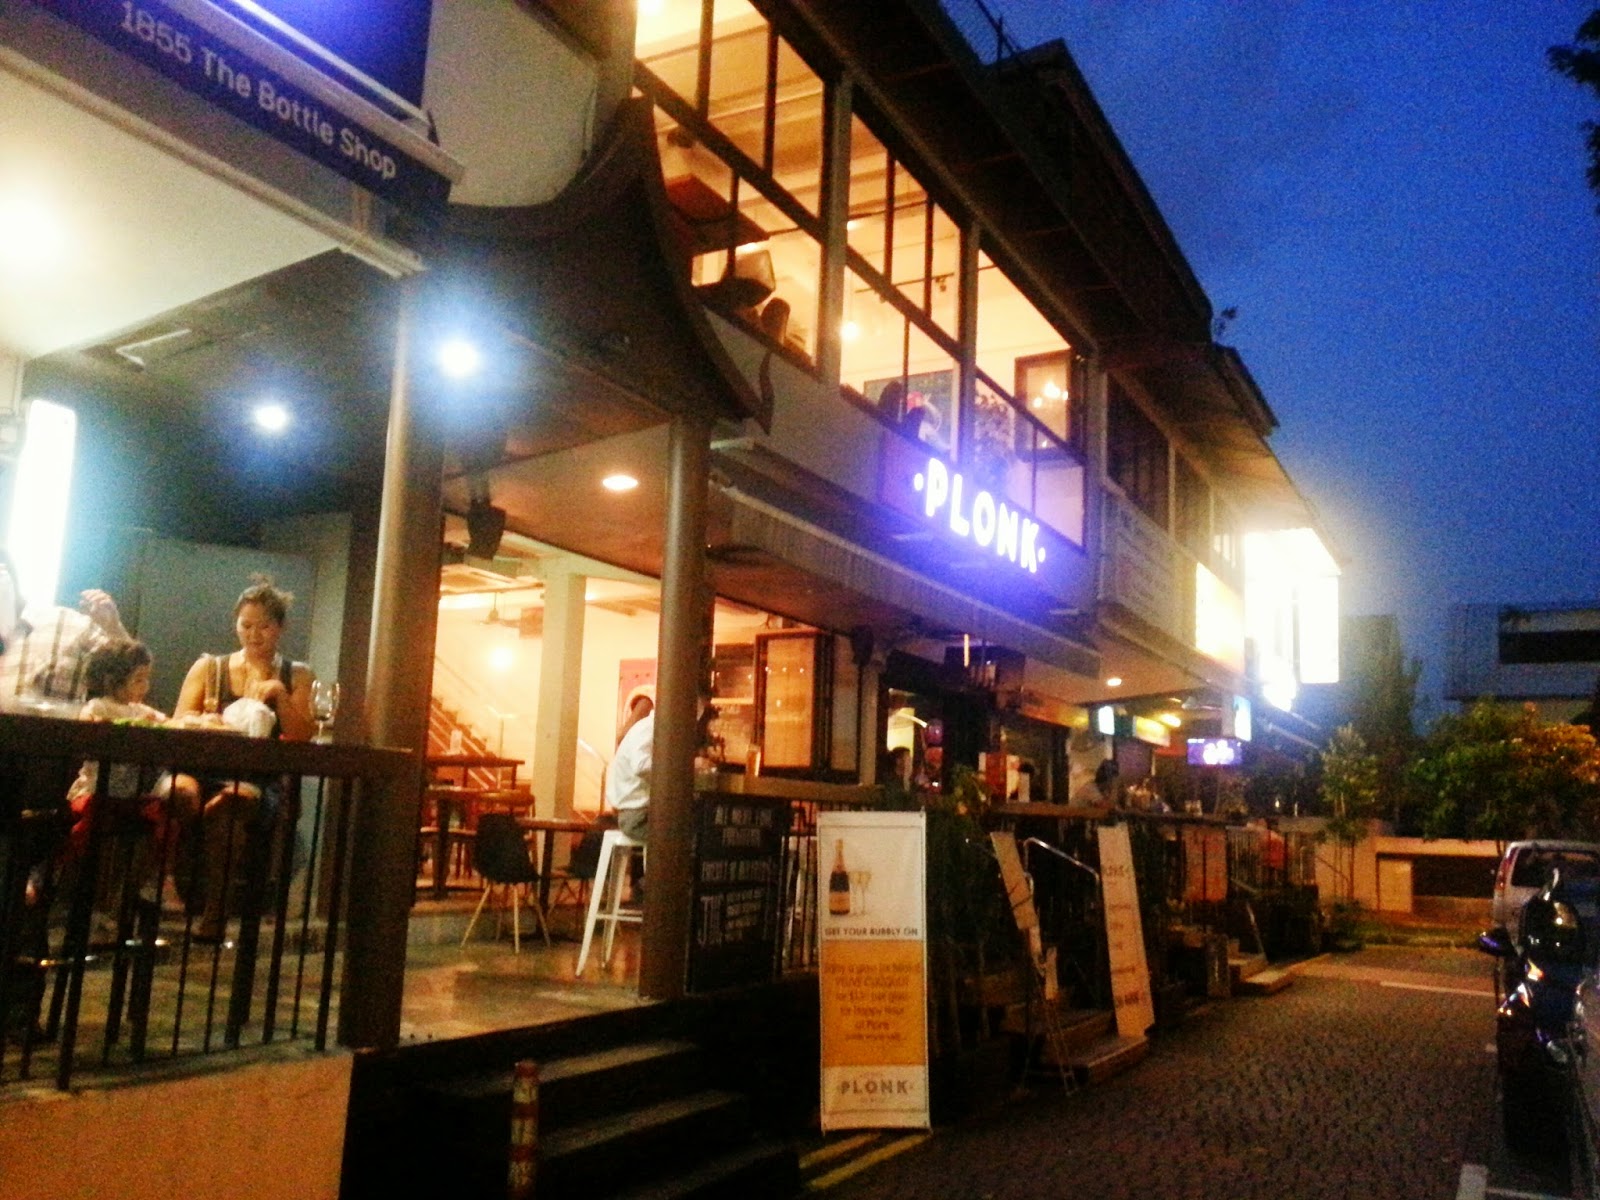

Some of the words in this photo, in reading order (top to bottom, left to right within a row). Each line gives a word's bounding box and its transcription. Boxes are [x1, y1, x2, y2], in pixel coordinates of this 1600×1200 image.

[122, 2, 192, 64] 1855
[203, 48, 252, 99] The
[257, 80, 335, 146] Bottle
[340, 128, 397, 181] Shop
[925, 457, 1039, 574] PLONK
[844, 927, 867, 937] YOUR
[870, 927, 900, 937] BUBBLY
[904, 927, 918, 937] ON
[840, 1079, 909, 1095] PLONK
